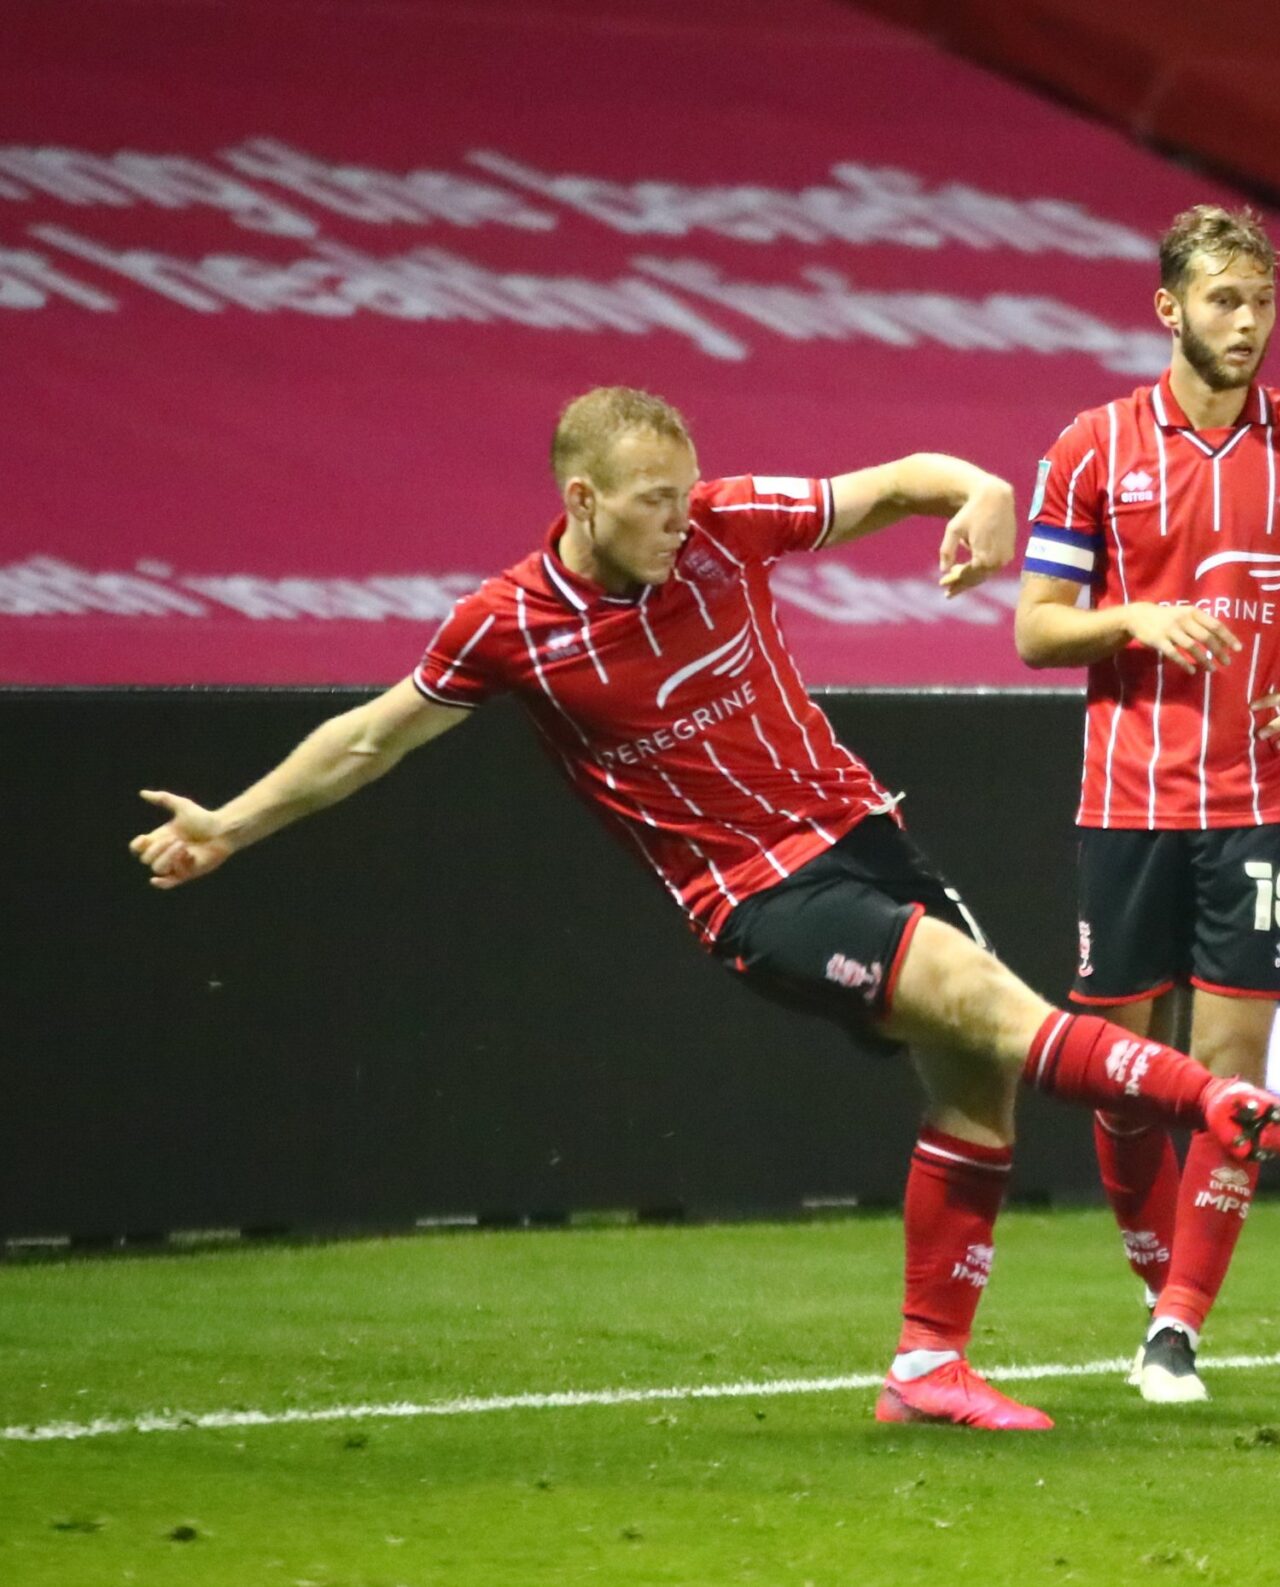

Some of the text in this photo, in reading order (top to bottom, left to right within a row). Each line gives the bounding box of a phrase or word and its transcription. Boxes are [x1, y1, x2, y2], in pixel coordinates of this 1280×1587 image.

[1158, 596, 1276, 625] GRINE
[601, 680, 757, 769] PEREGRINE
[1194, 1190, 1250, 1220] IMPS
[951, 1261, 988, 1289] IMP
